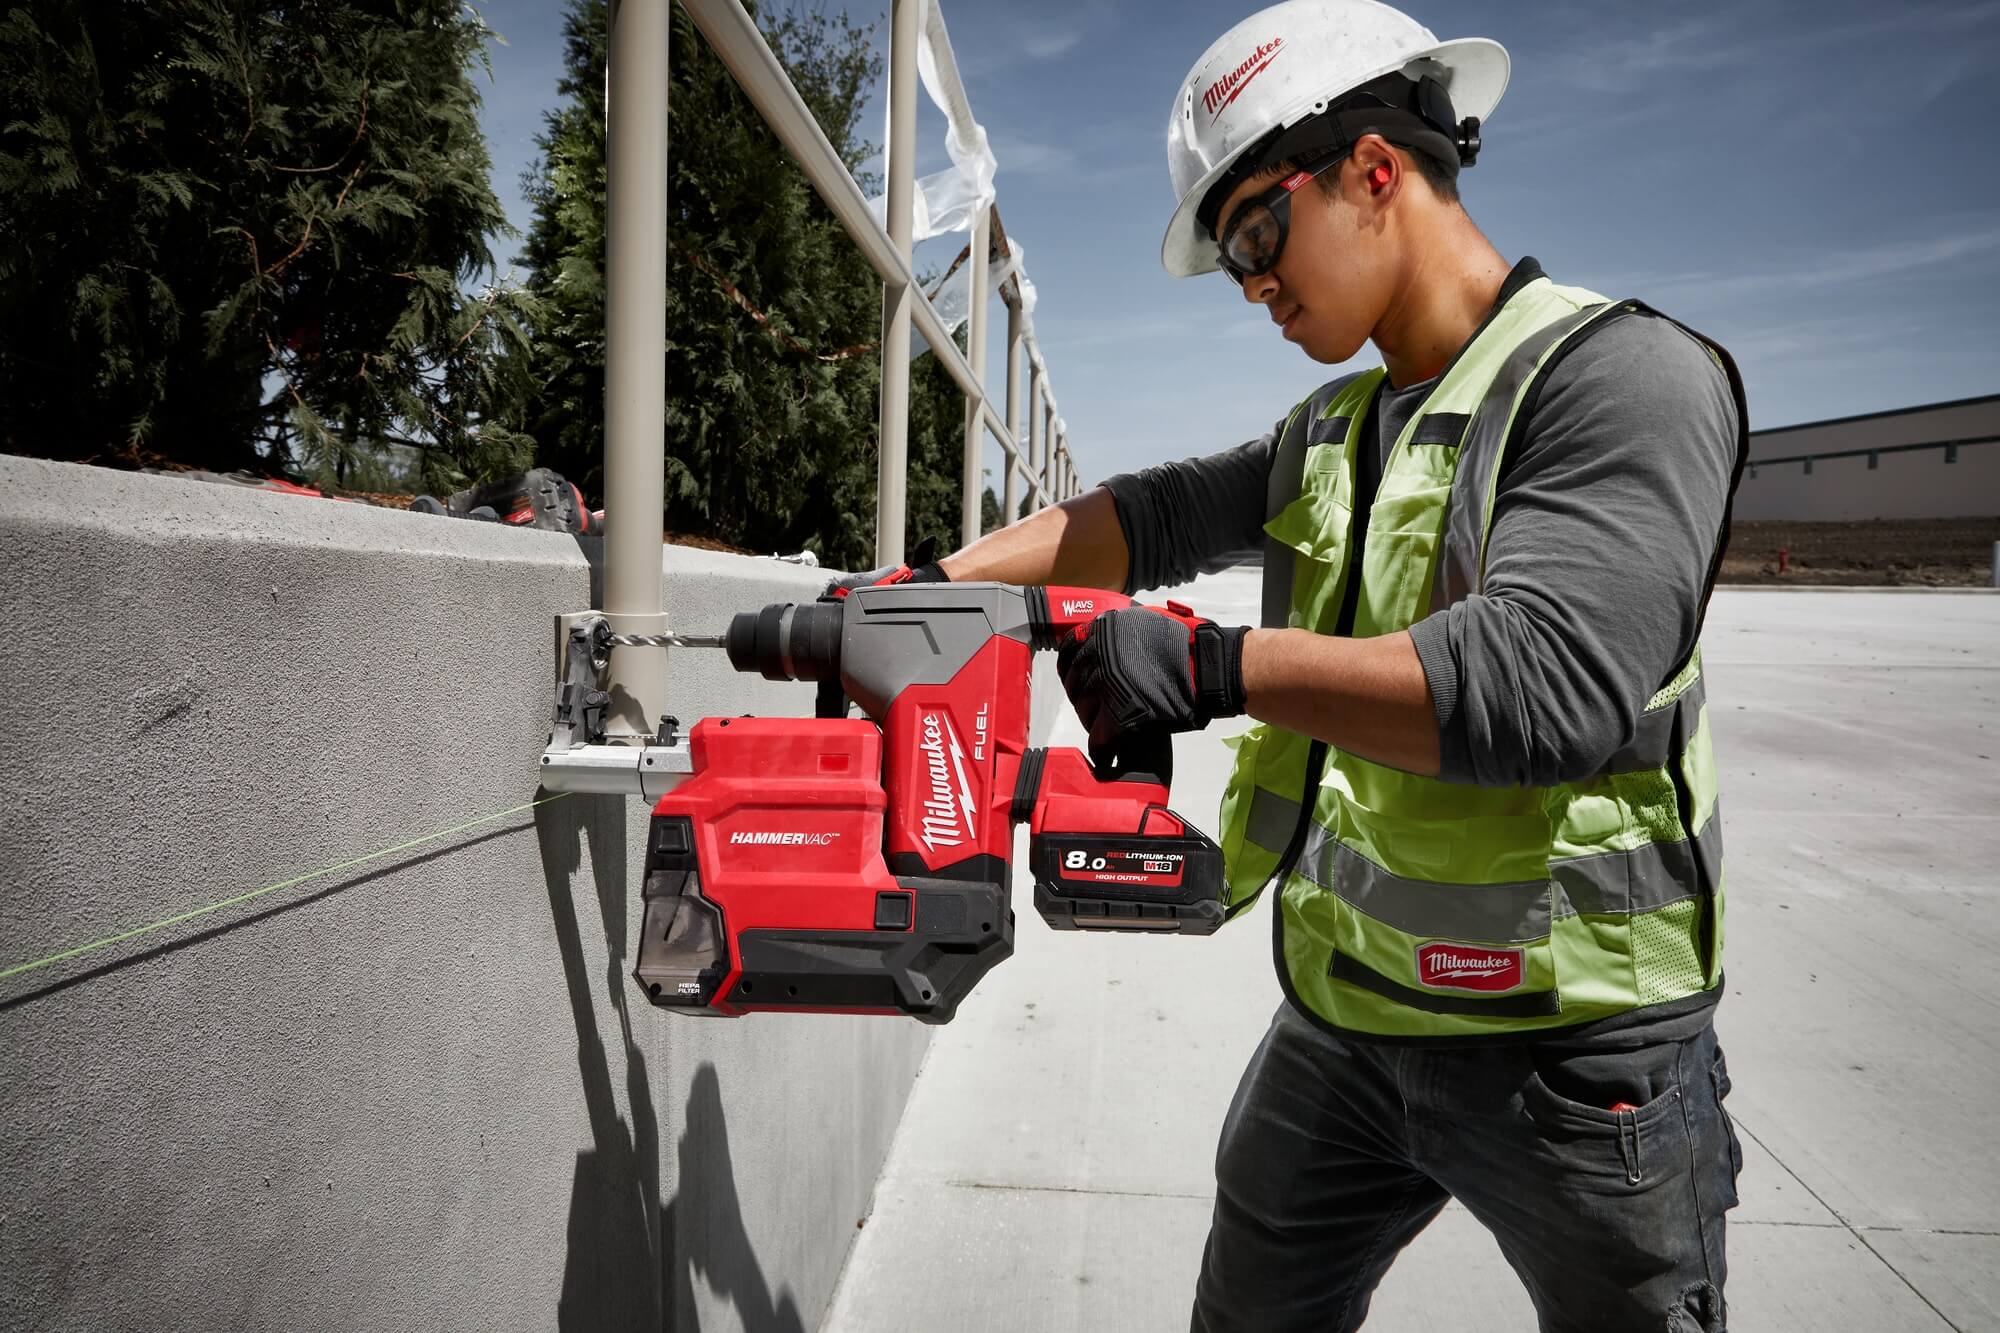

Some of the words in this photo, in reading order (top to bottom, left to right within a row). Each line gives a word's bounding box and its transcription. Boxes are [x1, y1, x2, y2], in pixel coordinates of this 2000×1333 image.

[1200, 38, 1282, 114] Milwaukee
[974, 702, 988, 761] FUEL
[920, 713, 964, 853] Milwaukee
[1065, 850, 1107, 871] 8.0
[1145, 861, 1171, 871] M18
[1095, 873, 1116, 881] HIGH
[1117, 874, 1149, 882] OUTPUT
[1424, 951, 1513, 974] Milwaukee
